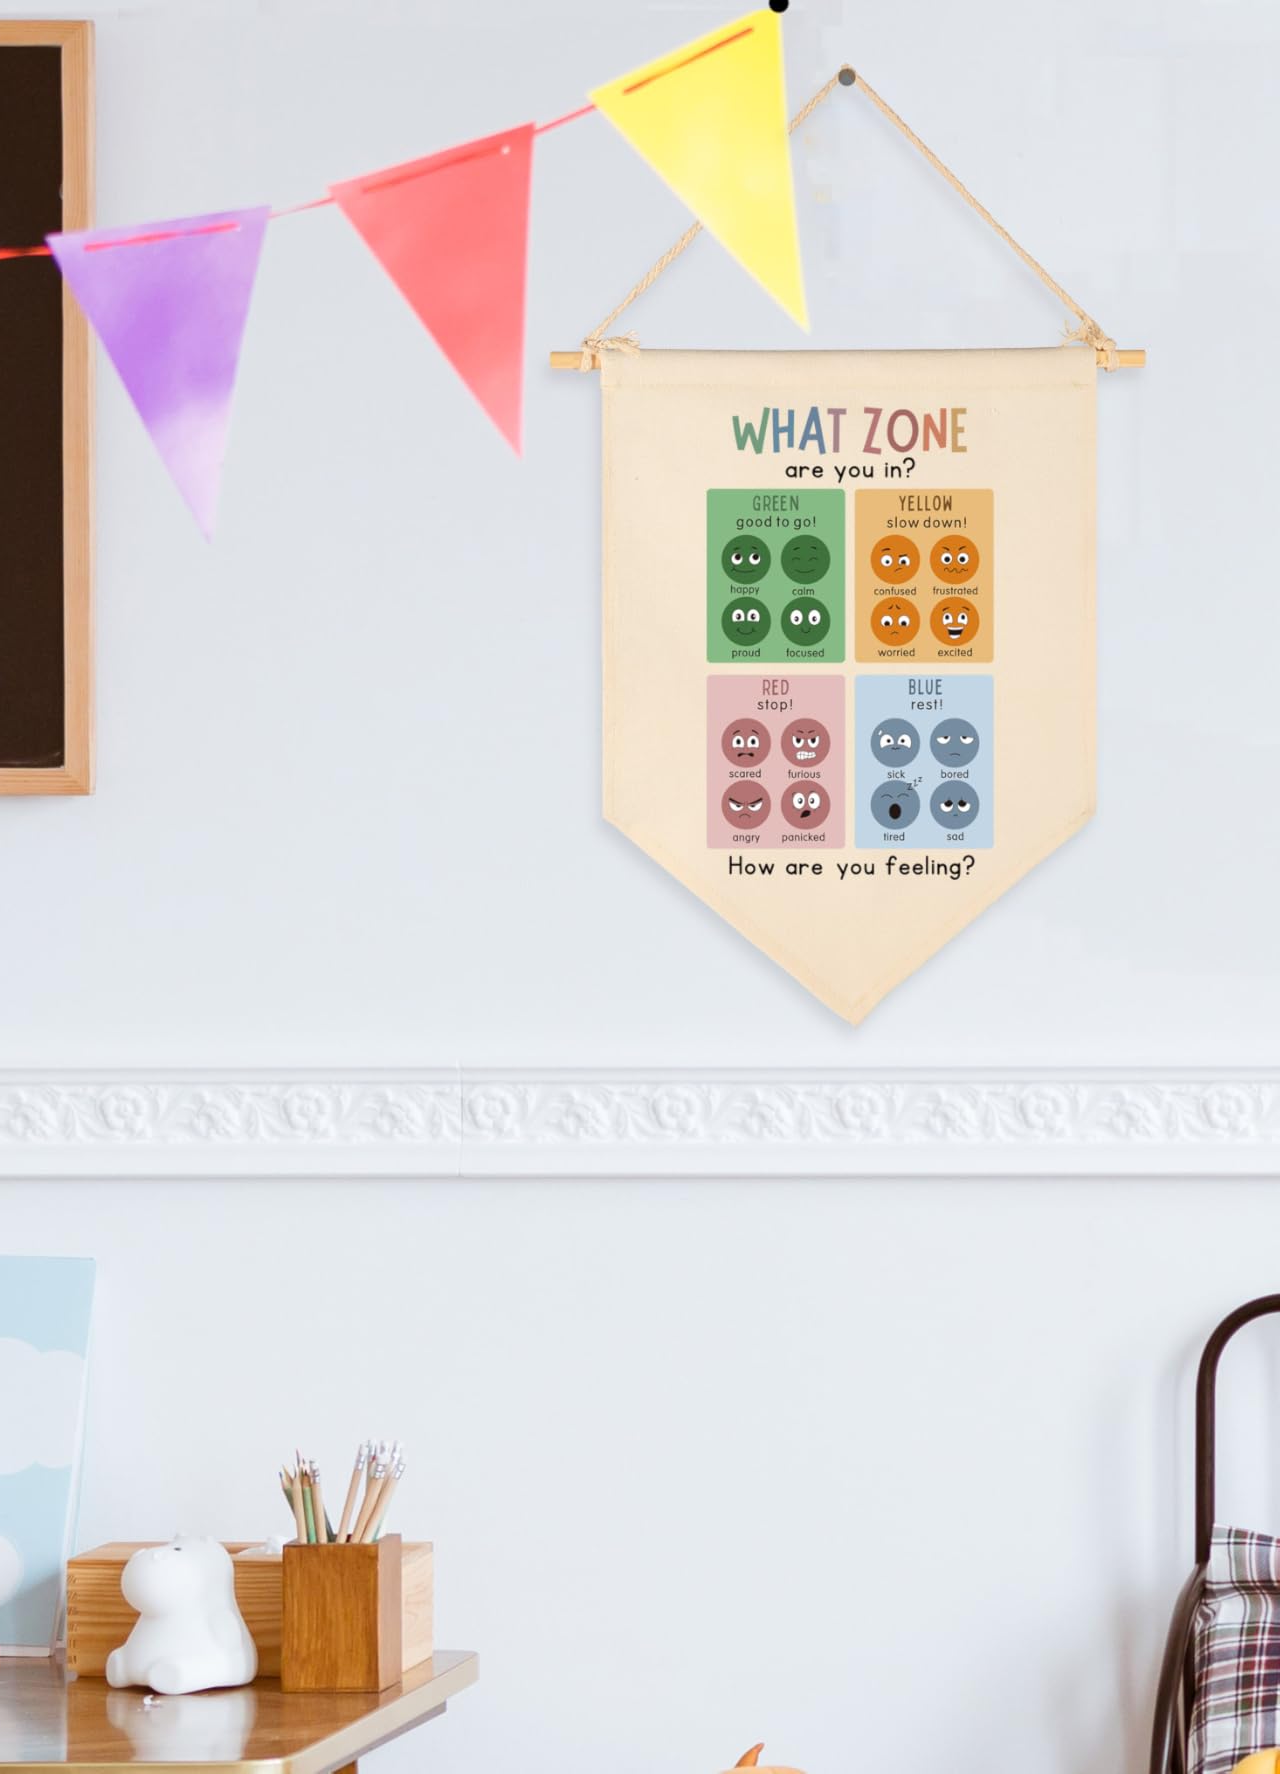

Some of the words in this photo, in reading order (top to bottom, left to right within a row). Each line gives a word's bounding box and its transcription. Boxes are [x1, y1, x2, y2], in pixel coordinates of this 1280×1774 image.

[732, 406, 847, 455] WHAT
[863, 406, 967, 455] ZONE
[785, 462, 824, 478] are
[835, 462, 874, 483] you
[884, 457, 916, 478] in?
[753, 495, 799, 511] GREEN
[899, 495, 952, 511] YELLOW
[736, 516, 772, 530] good
[776, 516, 789, 528] to
[793, 516, 817, 530] go!
[887, 516, 919, 528] slow
[923, 516, 967, 528] down!
[730, 585, 760, 595] happy
[792, 586, 814, 596] calm
[874, 586, 916, 596] confused
[933, 586, 978, 595] frustrated
[732, 648, 760, 659] proud
[786, 648, 824, 658] focused
[878, 648, 915, 657] worried
[937, 648, 973, 657] excited
[762, 679, 789, 696] RED
[908, 679, 943, 695] BLUE
[757, 699, 793, 712] stop!
[911, 699, 943, 710] rest!
[729, 769, 761, 778] scared
[788, 769, 821, 779] furious
[887, 769, 905, 779] sick
[941, 769, 969, 779] bored
[732, 833, 760, 843] angry
[782, 832, 825, 843] panicked
[883, 832, 905, 841] tired
[947, 832, 964, 841] sad
[728, 856, 775, 876] How
[786, 859, 823, 876] are
[837, 859, 875, 880] you
[886, 855, 975, 880] feeling?
